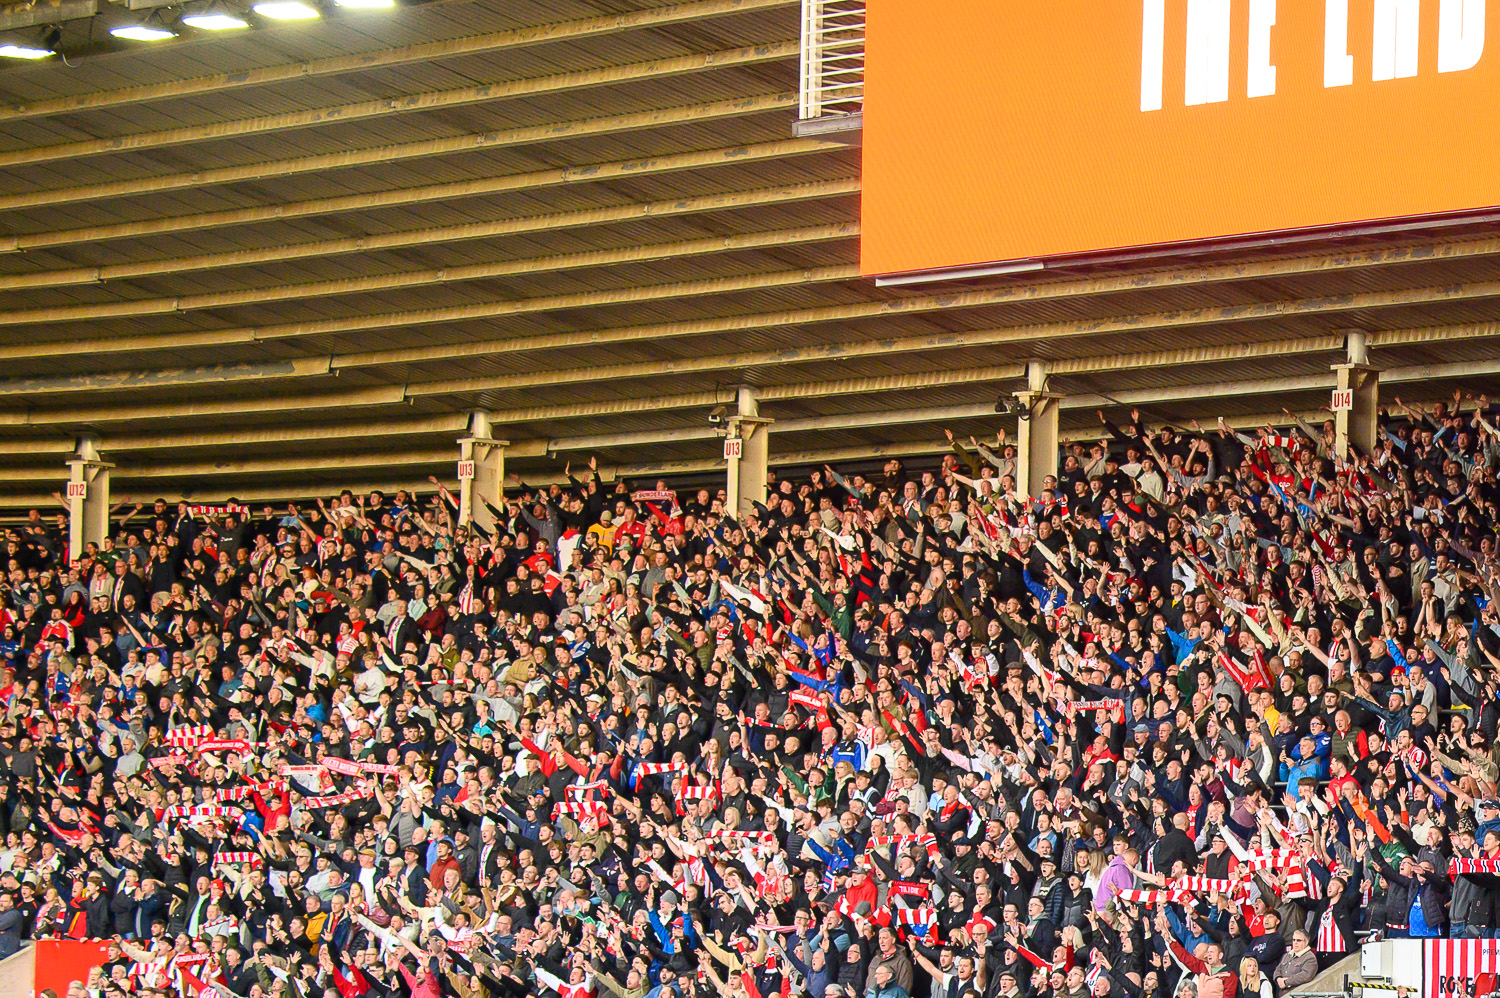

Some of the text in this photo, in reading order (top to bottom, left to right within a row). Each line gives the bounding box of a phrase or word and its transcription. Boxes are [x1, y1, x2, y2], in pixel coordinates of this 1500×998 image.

[1333, 392, 1351, 408] U14
[725, 442, 740, 456] U13
[459, 463, 473, 477] U13
[70, 483, 86, 497] U12
[1440, 976, 1474, 995] ROKE
